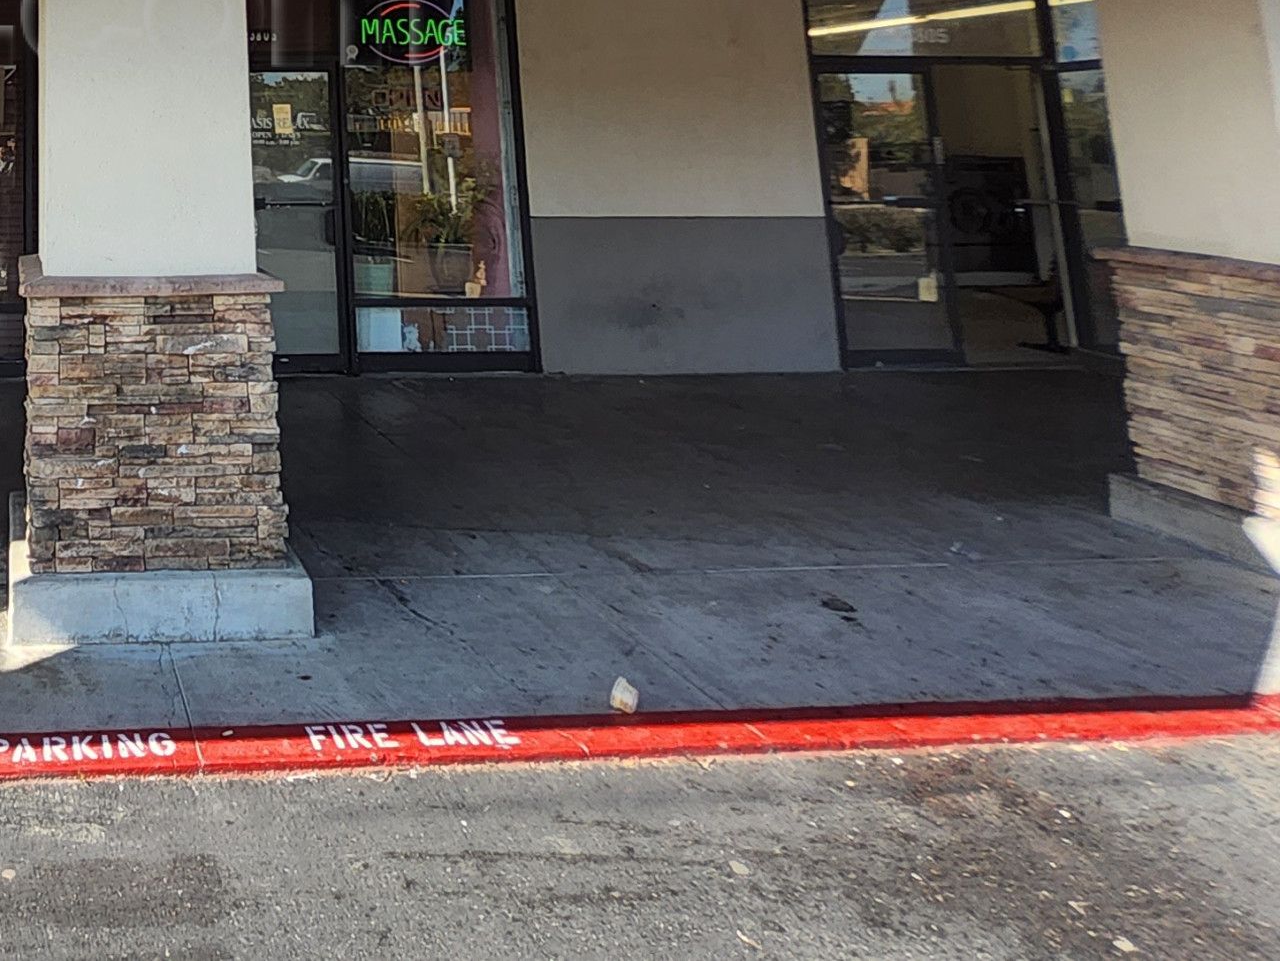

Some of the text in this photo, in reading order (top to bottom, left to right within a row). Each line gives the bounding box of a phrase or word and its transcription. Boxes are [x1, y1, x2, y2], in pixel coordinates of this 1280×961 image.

[360, 17, 467, 47] MASSAGE
[304, 718, 521, 752] FIRE LANE
